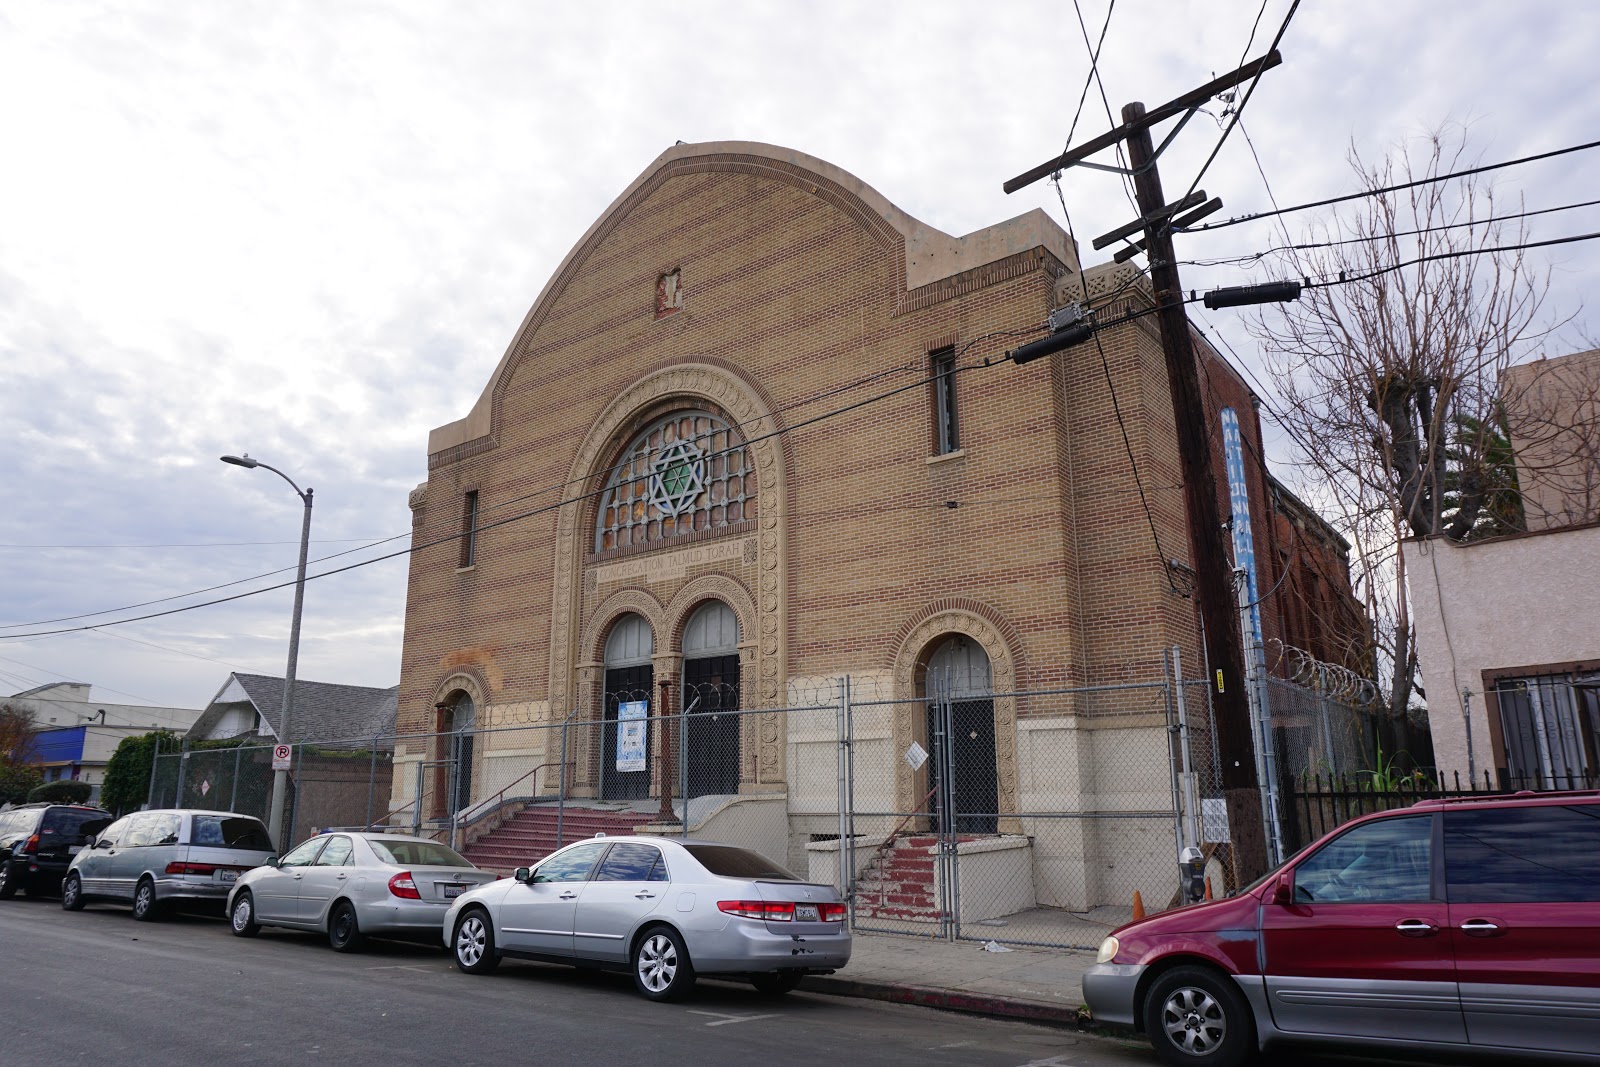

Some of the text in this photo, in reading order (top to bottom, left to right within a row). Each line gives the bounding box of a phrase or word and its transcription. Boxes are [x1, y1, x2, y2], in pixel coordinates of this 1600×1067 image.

[1231, 410, 1254, 554] NATIONAL
[668, 550, 702, 567] TALMUD
[706, 543, 740, 560] TORAH
[648, 572, 658, 580] LOS
